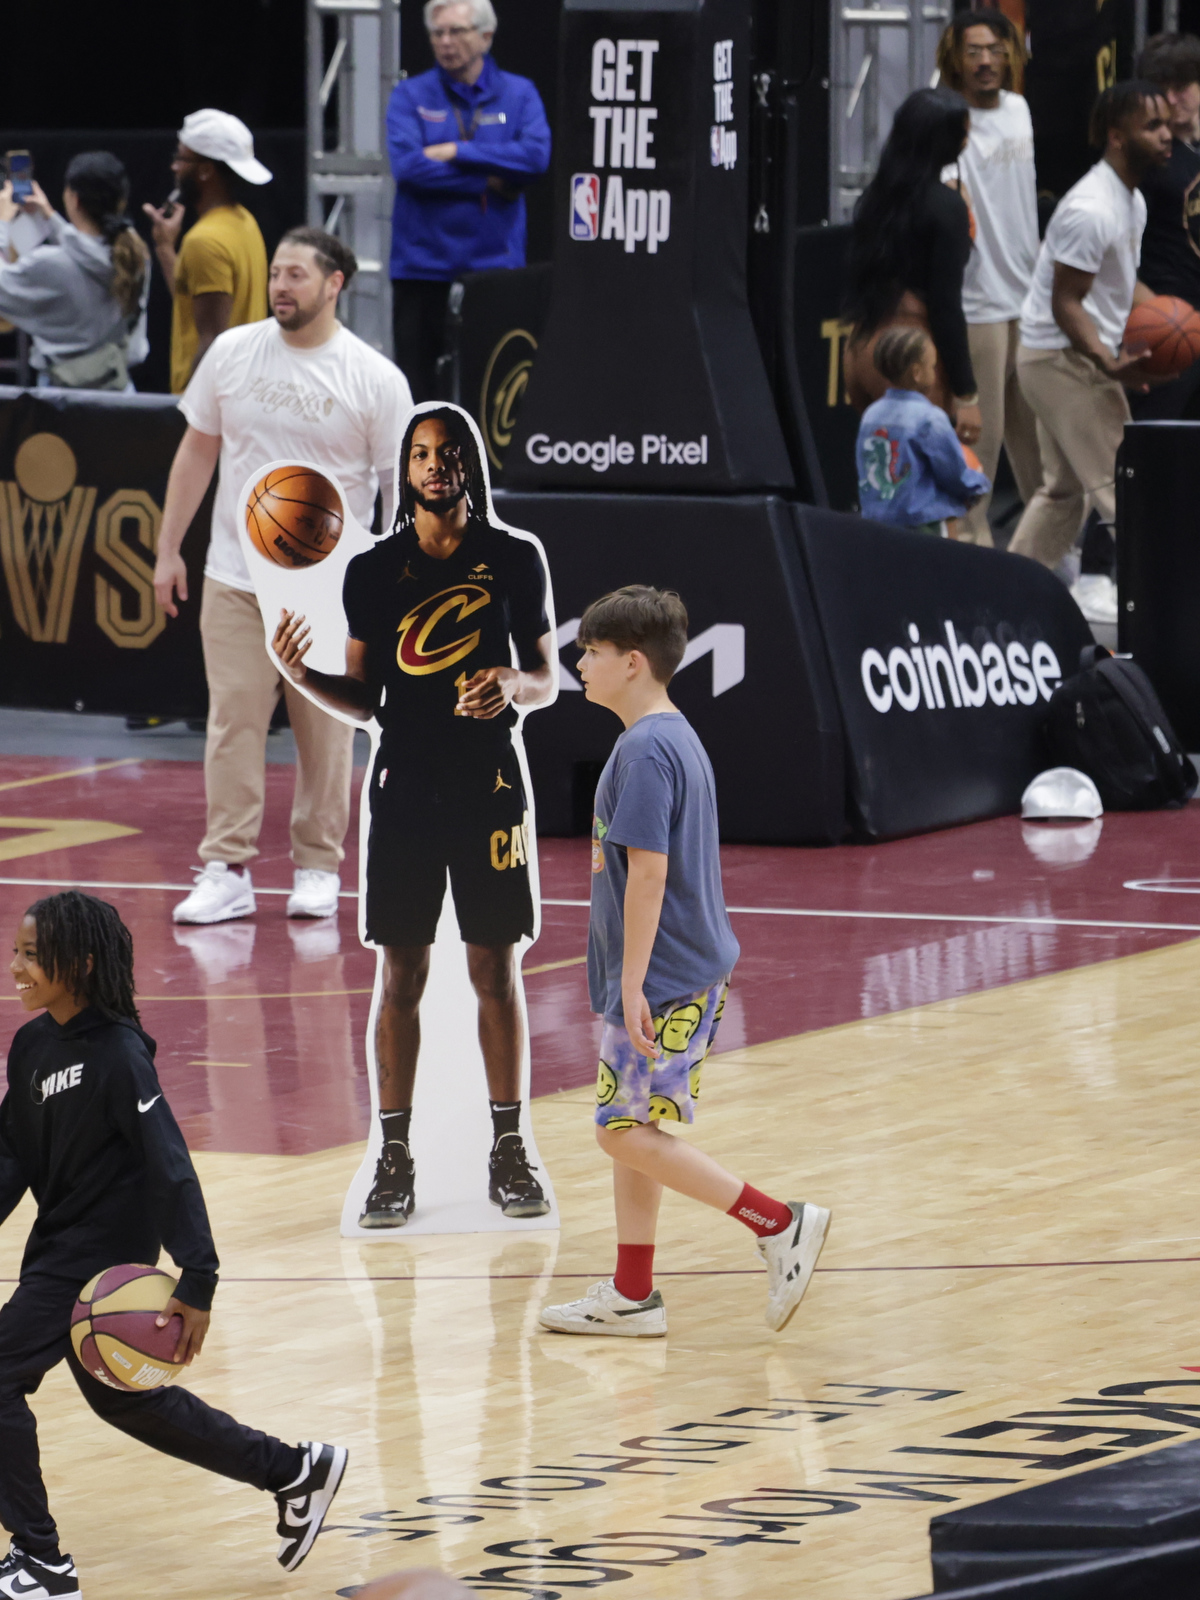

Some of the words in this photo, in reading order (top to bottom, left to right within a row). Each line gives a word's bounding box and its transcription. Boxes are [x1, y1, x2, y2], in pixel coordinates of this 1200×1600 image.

[590, 38, 660, 101] GET
[712, 39, 734, 82] GET
[712, 81, 734, 123] THE
[588, 106, 658, 169] THE
[601, 174, 671, 254] App
[525, 433, 635, 473] Google
[641, 433, 708, 466] Pixel
[467, 573, 494, 581] CLIFFS
[860, 619, 1064, 714] coinbase
[40, 1062, 85, 1103] NIKE
[737, 1206, 767, 1227] adidas
[318, 1382, 964, 1542] FIELDHOUSE
